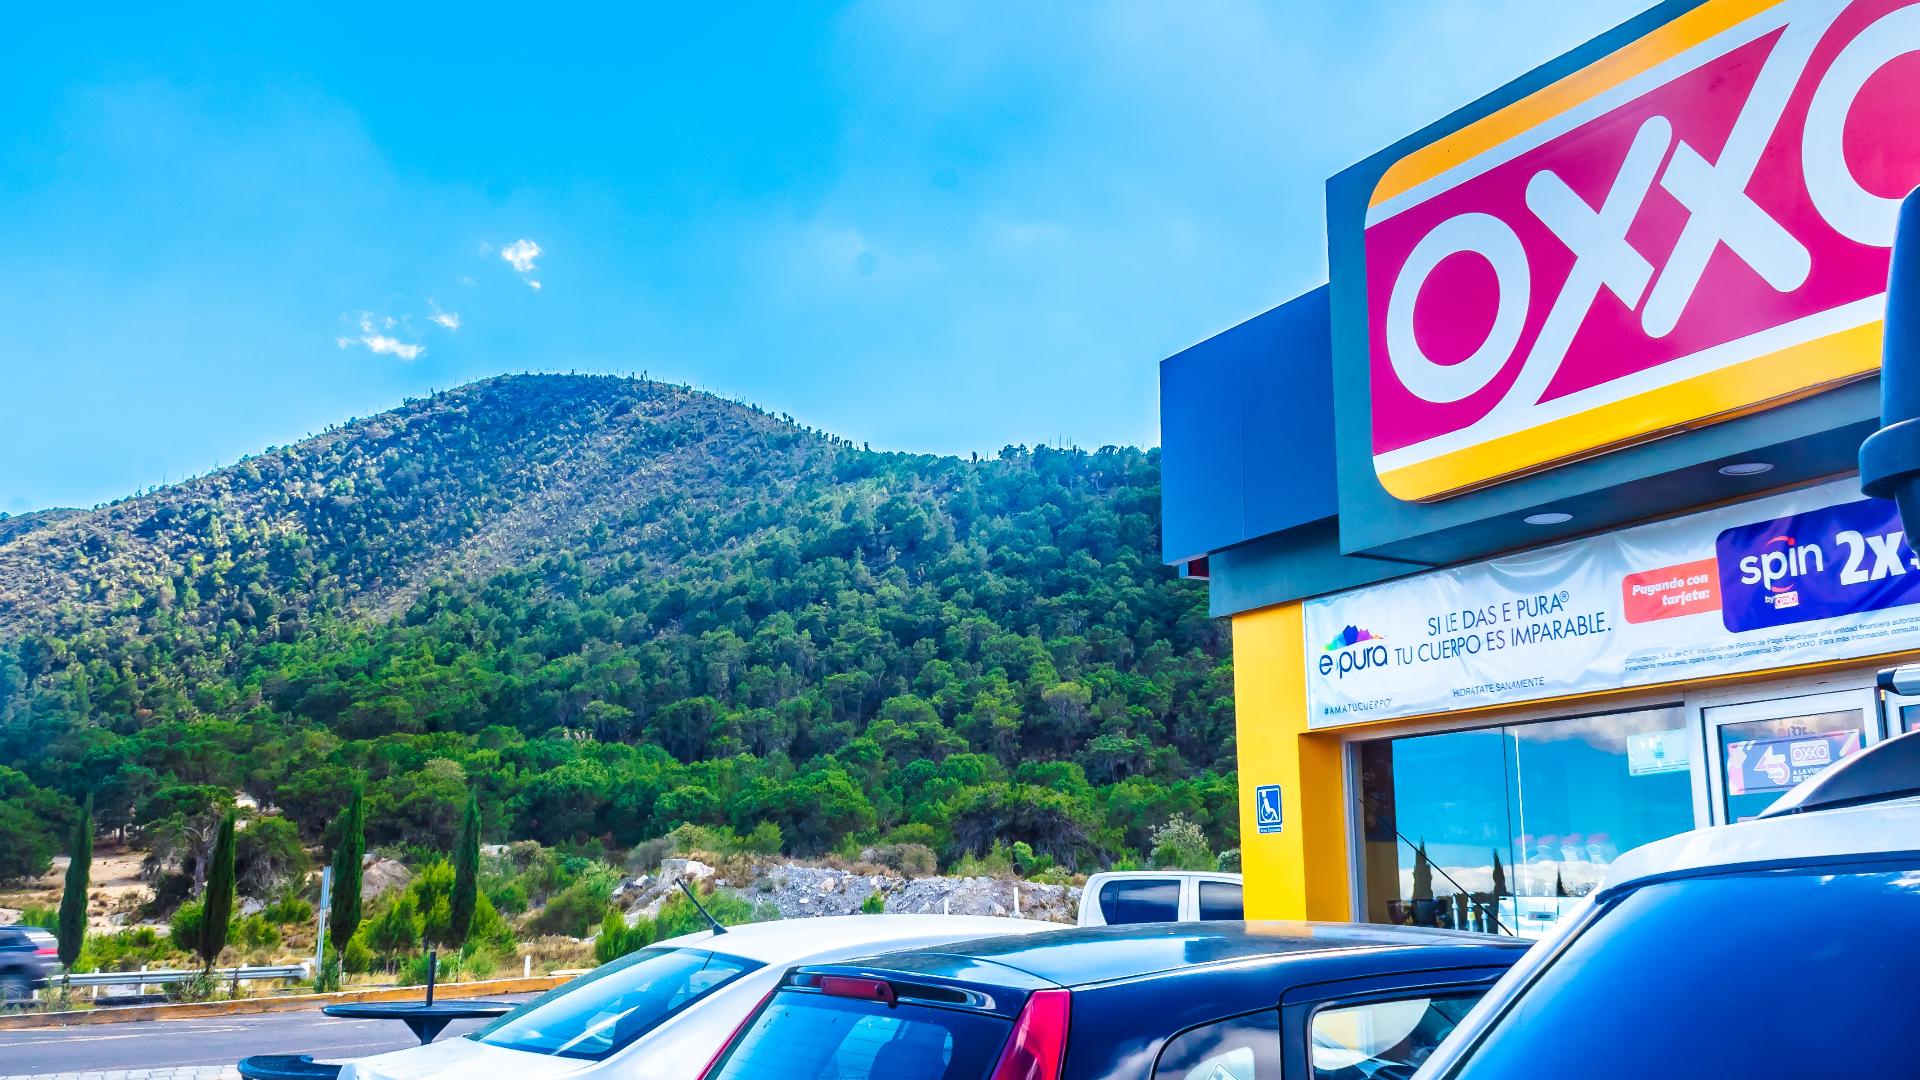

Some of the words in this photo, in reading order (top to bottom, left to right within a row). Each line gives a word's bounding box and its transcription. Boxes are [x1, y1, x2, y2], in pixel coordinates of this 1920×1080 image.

[1740, 536, 1823, 590] spin
[1632, 578, 1684, 596] Pagando
[1687, 574, 1709, 585] con
[1662, 589, 1710, 606] tarjeta:
[1428, 616, 1441, 636] SI
[1446, 612, 1458, 633] LE
[1463, 605, 1497, 630] DAS
[1502, 602, 1512, 623] E
[1395, 647, 1413, 667] TU
[1419, 634, 1481, 662] CUERPO
[1486, 630, 1506, 651] ES
[1511, 611, 1612, 647] IMPARABLE.
[1767, 637, 1784, 646] Pago
[1833, 625, 1858, 635] entidad
[1773, 644, 1787, 654] Spin
[1819, 638, 1835, 647] Para
[1453, 684, 1495, 698] HIDRATATE
[1495, 676, 1545, 692] SANAMENTE
[1793, 745, 1827, 761] OXXO
